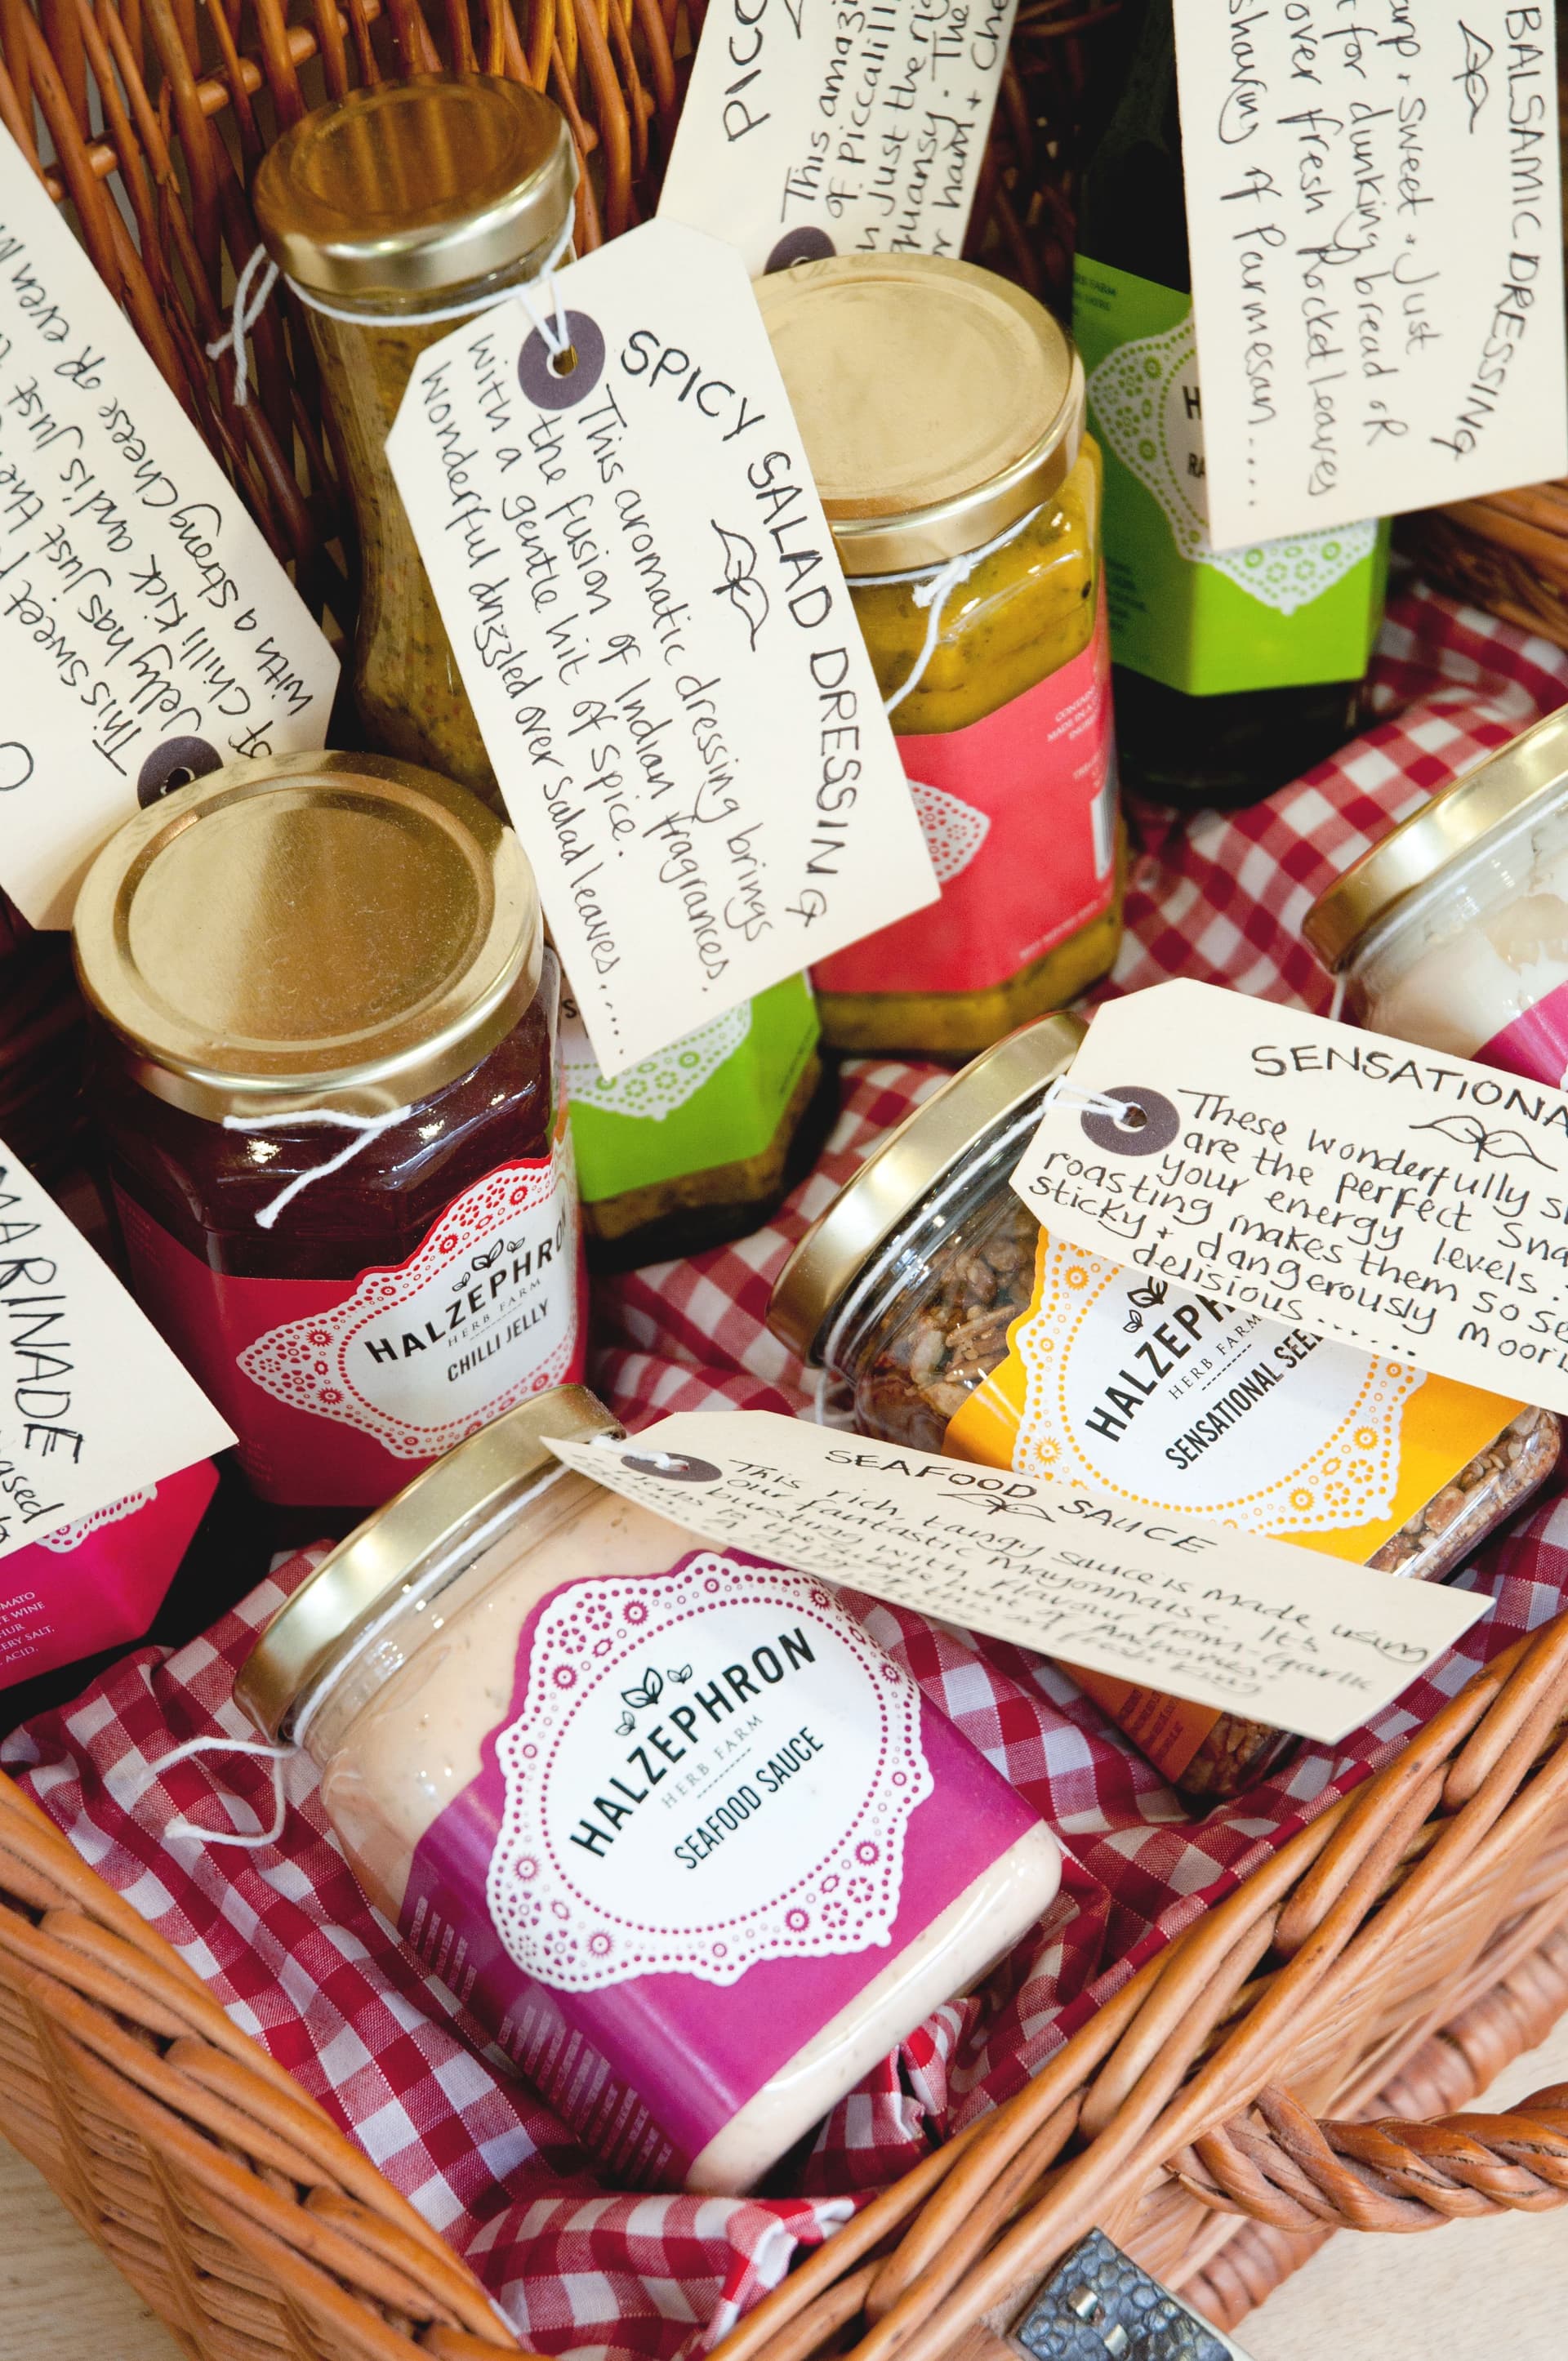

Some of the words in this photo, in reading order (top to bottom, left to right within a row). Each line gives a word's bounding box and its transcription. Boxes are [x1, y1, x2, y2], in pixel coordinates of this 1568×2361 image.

[884, 56, 926, 110] the
[931, 5, 969, 81] The
[1284, 2, 1321, 85] over
[1323, 27, 1379, 80] for
[1277, 108, 1343, 214] fresh
[1506, 7, 1546, 241] BALSAMIC
[782, 131, 830, 222] This
[826, 176, 860, 218] of
[1221, 167, 1283, 202] of
[1334, 101, 1395, 263] dunking
[12, 263, 69, 343] even
[1354, 270, 1399, 377] bread
[468, 333, 510, 432] with
[621, 330, 765, 442] SPICY
[1432, 252, 1539, 462] DRESSING
[496, 447, 522, 473] a
[527, 414, 566, 486] the
[1309, 370, 1347, 496] leaves
[72, 488, 133, 552] and
[168, 503, 238, 608] strong
[503, 495, 558, 613] gentle
[545, 492, 612, 616] fusion
[747, 450, 833, 628] SALAD
[4, 581, 87, 686] sweet
[78, 595, 134, 666] has
[234, 608, 256, 631] a
[422, 361, 500, 568] wonderful
[470, 577, 542, 698] drizzled
[515, 706, 564, 768] over
[544, 776, 595, 867] salad
[546, 613, 592, 685] hit
[578, 384, 626, 484] This
[614, 488, 689, 667] aromatic
[675, 673, 742, 822] dressing
[724, 822, 773, 942] brings
[599, 634, 641, 666] of
[256, 637, 313, 716] with
[568, 701, 617, 735] of
[82, 683, 142, 776] This
[614, 678, 675, 800] Indian
[786, 648, 862, 928] DRESSING
[1156, 1153, 1250, 1196] your
[1267, 1191, 1404, 1250] energy
[1177, 1089, 1288, 1139] These
[1308, 1129, 1530, 1217] wonderfully
[1183, 1131, 1241, 1163] are
[1254, 1147, 1315, 1186] the
[1336, 1172, 1472, 1232] perfect
[1028, 1173, 1148, 1240] sticky
[1197, 1232, 1439, 1334] dangerously
[1043, 1151, 1214, 1225] roasting
[1228, 1214, 1343, 1263] makes
[1359, 1245, 1459, 1302] them
[364, 1198, 567, 1363] HALZEPHRON
[448, 1313, 491, 1348] HERB
[499, 1278, 541, 1311] FARM
[447, 1338, 501, 1382] CHILLI
[506, 1299, 549, 1343] JELLY
[1085, 1294, 1236, 1442] HALZEP
[1168, 1357, 1214, 1400] HERB
[1216, 1314, 1263, 1355] FARM
[1165, 1361, 1283, 1470] SENSATIONAL
[1273, 1329, 1325, 1369] SEE
[706, 1487, 862, 1544] bursting
[875, 1544, 968, 1577] with
[727, 1479, 795, 1498] our
[795, 1499, 973, 1557] fantastic
[824, 1450, 1040, 1500] SEAFOOD
[1058, 1500, 1218, 1554] SAUCE
[11, 1601, 45, 1619] WINE
[728, 1459, 802, 1490] This
[922, 1515, 1045, 1558] tangy
[1331, 1624, 1428, 1667] using
[569, 1627, 817, 1857] HALZEPHRON
[661, 1762, 710, 1809] HERB
[715, 1714, 764, 1760] FARM
[674, 1784, 764, 1870] SEAFOOD
[755, 1726, 824, 1793] SAUCE
